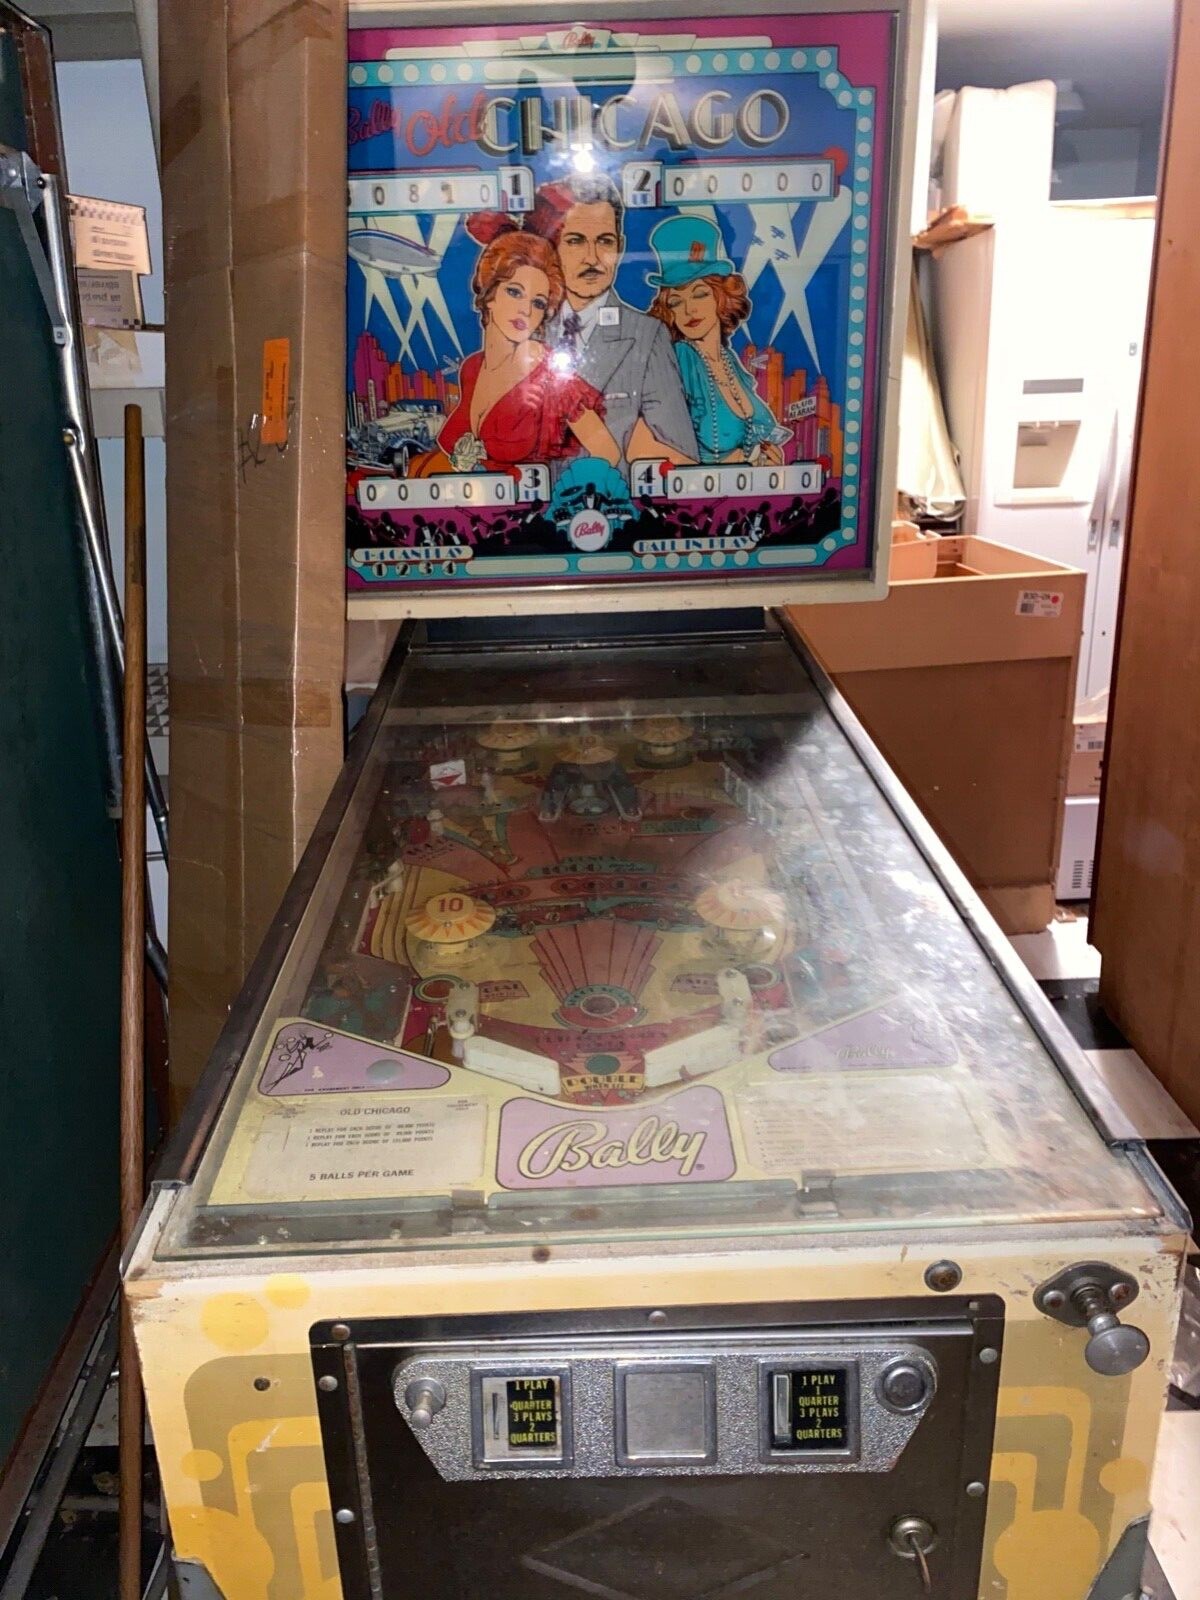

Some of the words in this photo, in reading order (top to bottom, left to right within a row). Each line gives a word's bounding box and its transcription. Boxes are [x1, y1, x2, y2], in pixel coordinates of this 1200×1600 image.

[406, 89, 487, 157] Old
[477, 88, 790, 158] CHICAGO
[508, 173, 522, 196] 1
[632, 168, 651, 192] 2
[523, 467, 541, 489] 3
[637, 466, 656, 484] 4
[574, 519, 605, 537] Bally
[438, 896, 464, 913] 10
[340, 1108, 361, 1117] OLD
[363, 1106, 412, 1116] CHICAGO
[517, 1114, 708, 1180] Bally
[309, 1173, 317, 1181] 5
[319, 1171, 354, 1180] BALLS
[357, 1170, 380, 1179] PER
[382, 1168, 416, 1177] GAME
[515, 1380, 520, 1391] 1
[523, 1379, 548, 1390] PLAY
[802, 1375, 808, 1386] 1
[810, 1374, 836, 1385] PLAY
[528, 1389, 534, 1400] 1
[815, 1385, 821, 1396] 1
[510, 1399, 553, 1412] QUARTER
[798, 1395, 840, 1407] QUARTER
[513, 1411, 520, 1422] 3
[522, 1410, 553, 1422] PLAYS
[799, 1407, 806, 1418] 3
[808, 1406, 840, 1418] PLAYS
[529, 1421, 536, 1433] 2
[815, 1418, 822, 1429] 2
[509, 1430, 556, 1445] QUARTERS
[796, 1427, 843, 1441] QUARTERS
